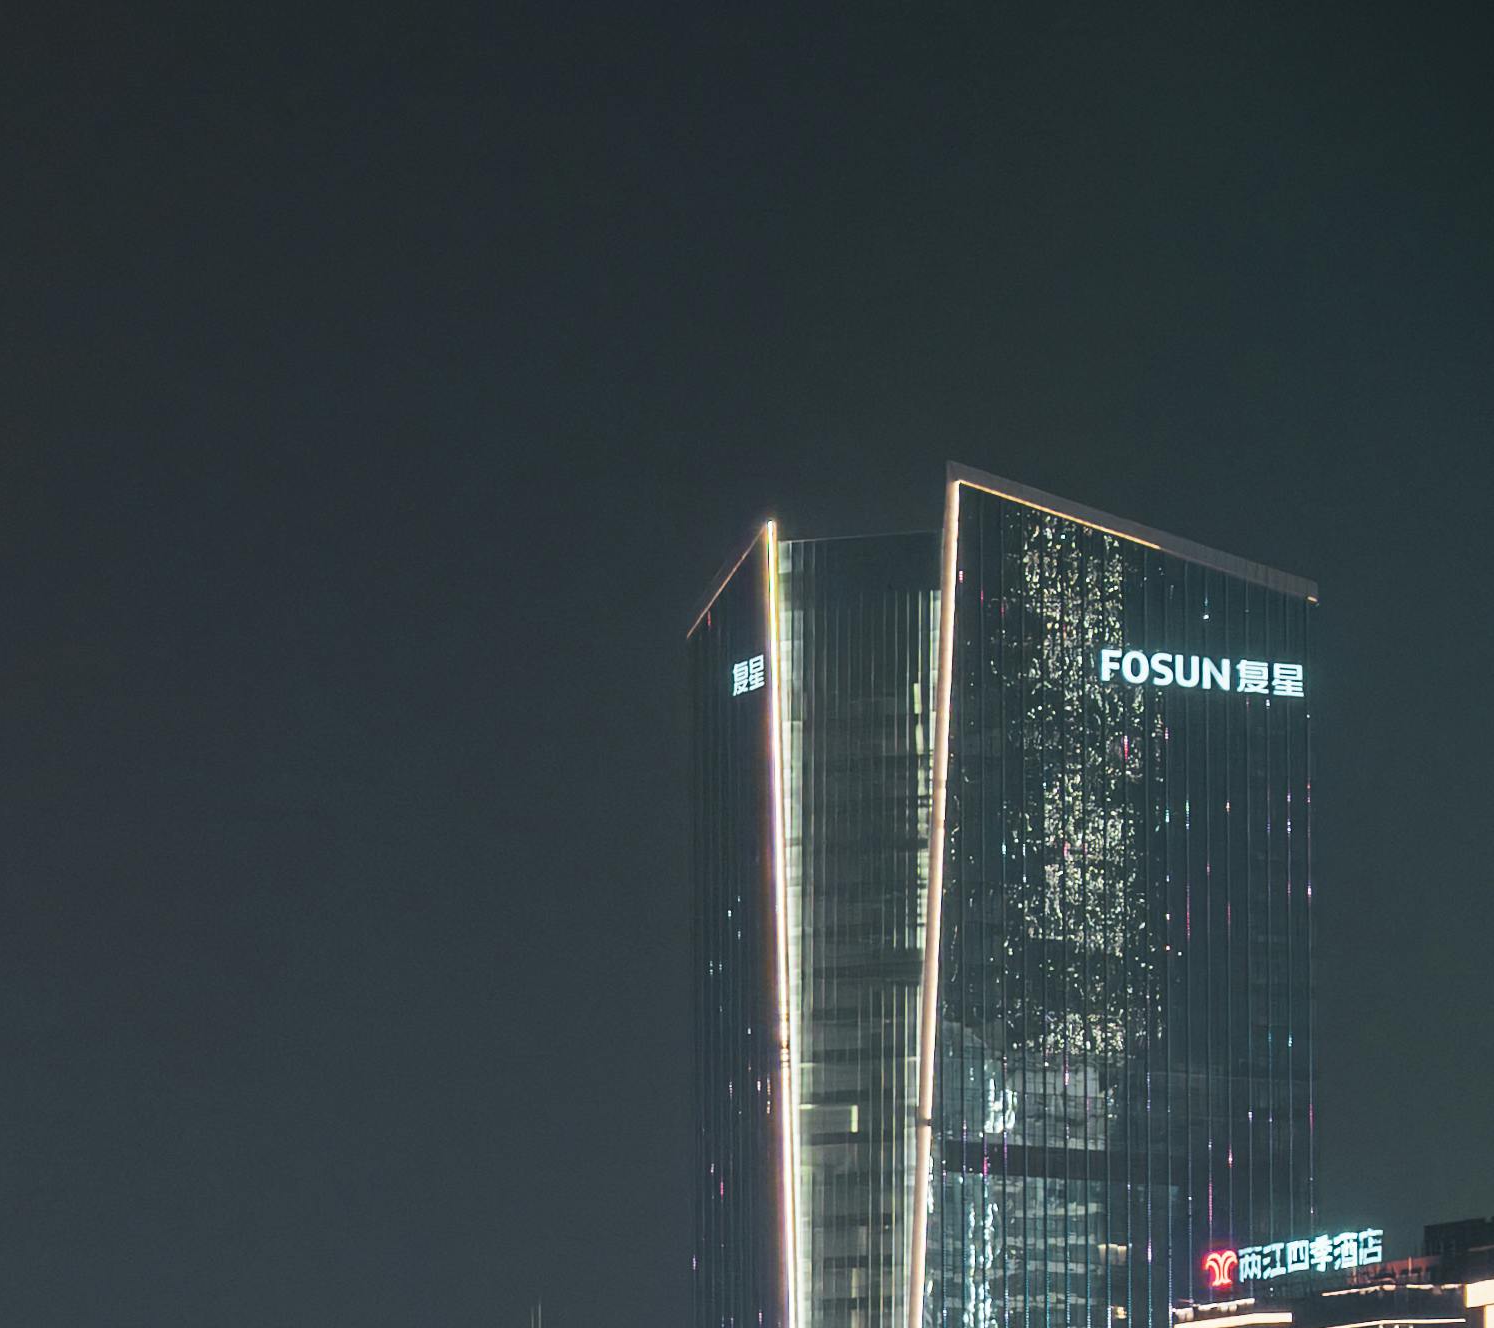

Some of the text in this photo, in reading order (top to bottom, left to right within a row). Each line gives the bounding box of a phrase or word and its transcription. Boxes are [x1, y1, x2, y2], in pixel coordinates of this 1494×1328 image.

[731, 653, 766, 697] 复星
[1100, 648, 1305, 698] FOSUN 复星
[1237, 1228, 1384, 1283] 两江四季酒店
